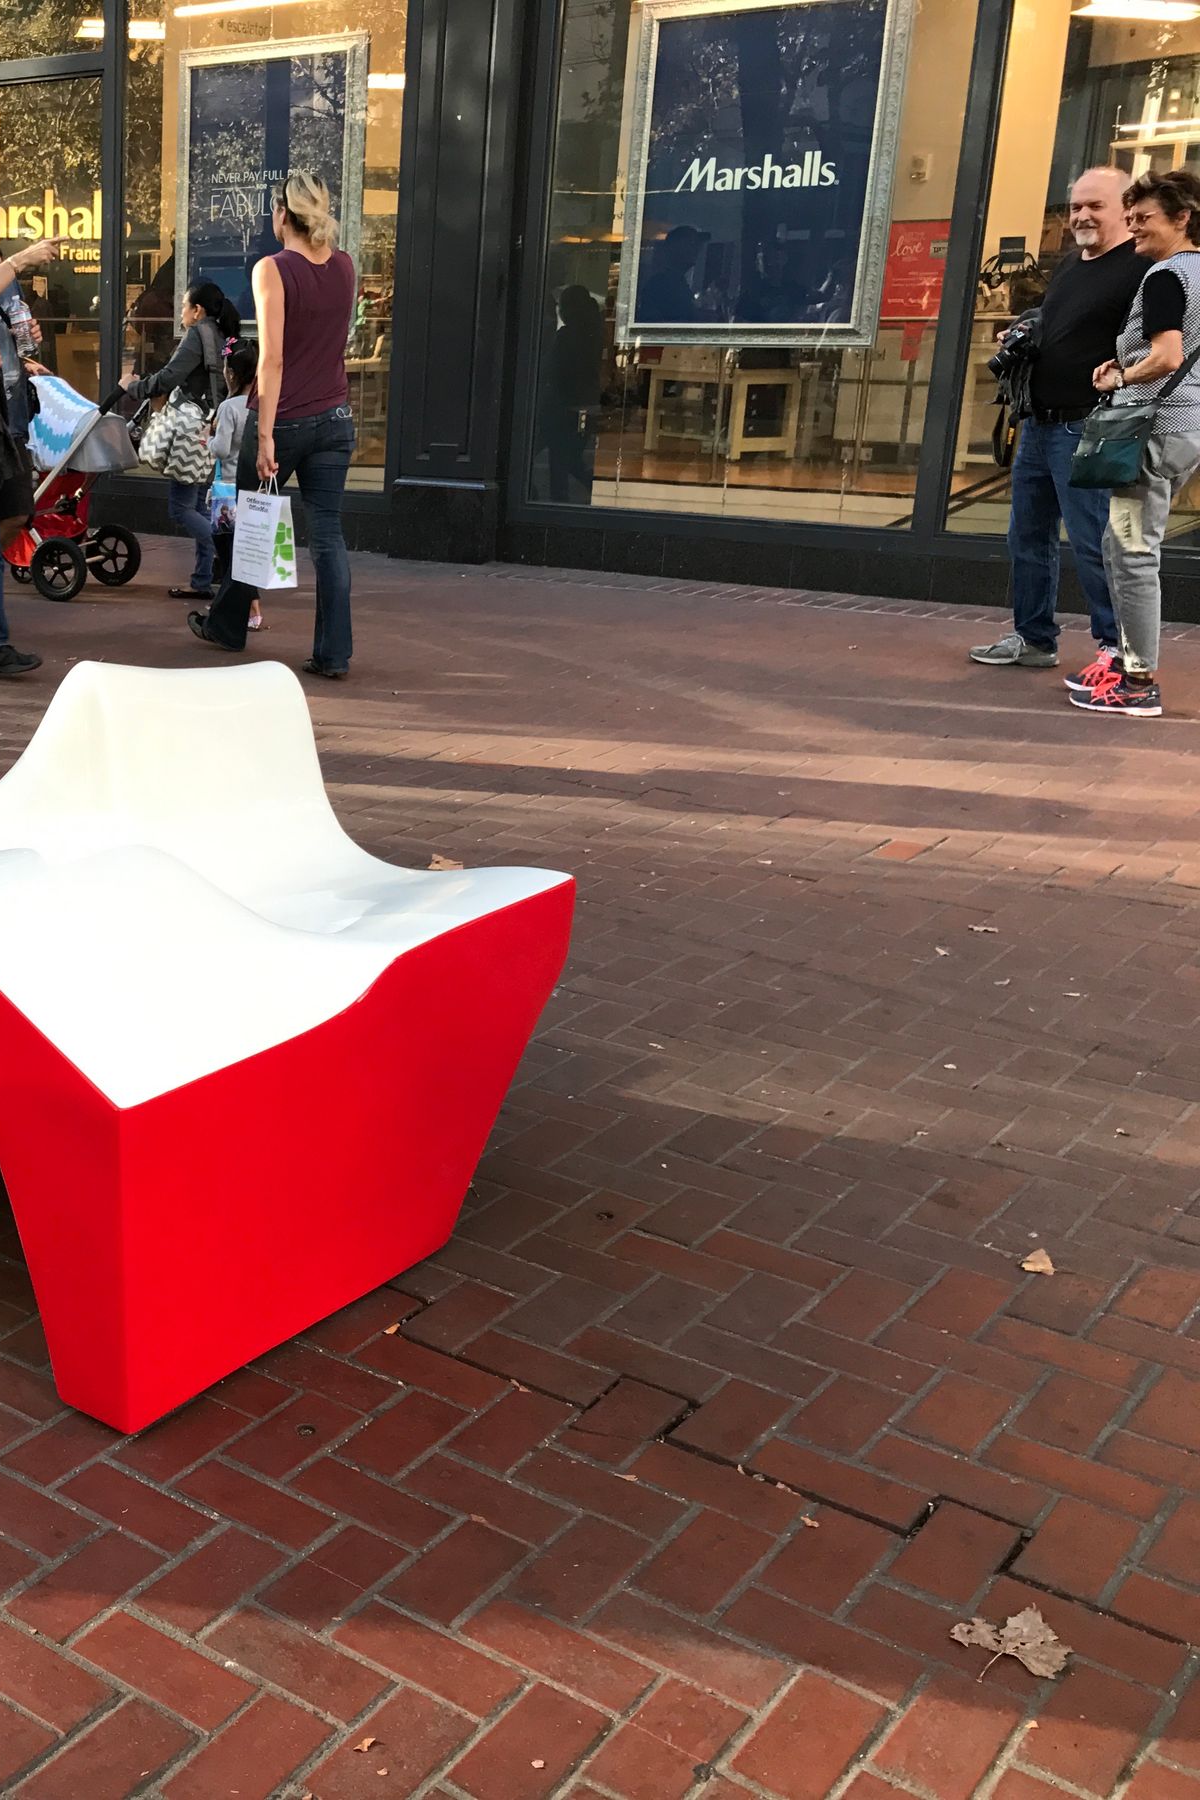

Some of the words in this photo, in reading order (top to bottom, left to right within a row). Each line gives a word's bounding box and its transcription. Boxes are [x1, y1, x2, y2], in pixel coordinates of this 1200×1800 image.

[211, 172, 241, 184] NEVER
[243, 170, 261, 182] PAY
[263, 169, 285, 181] FULL
[674, 150, 836, 193] Marshalls
[210, 192, 276, 222] FABUL
[59, 245, 101, 261] Franc
[891, 235, 925, 258] love
